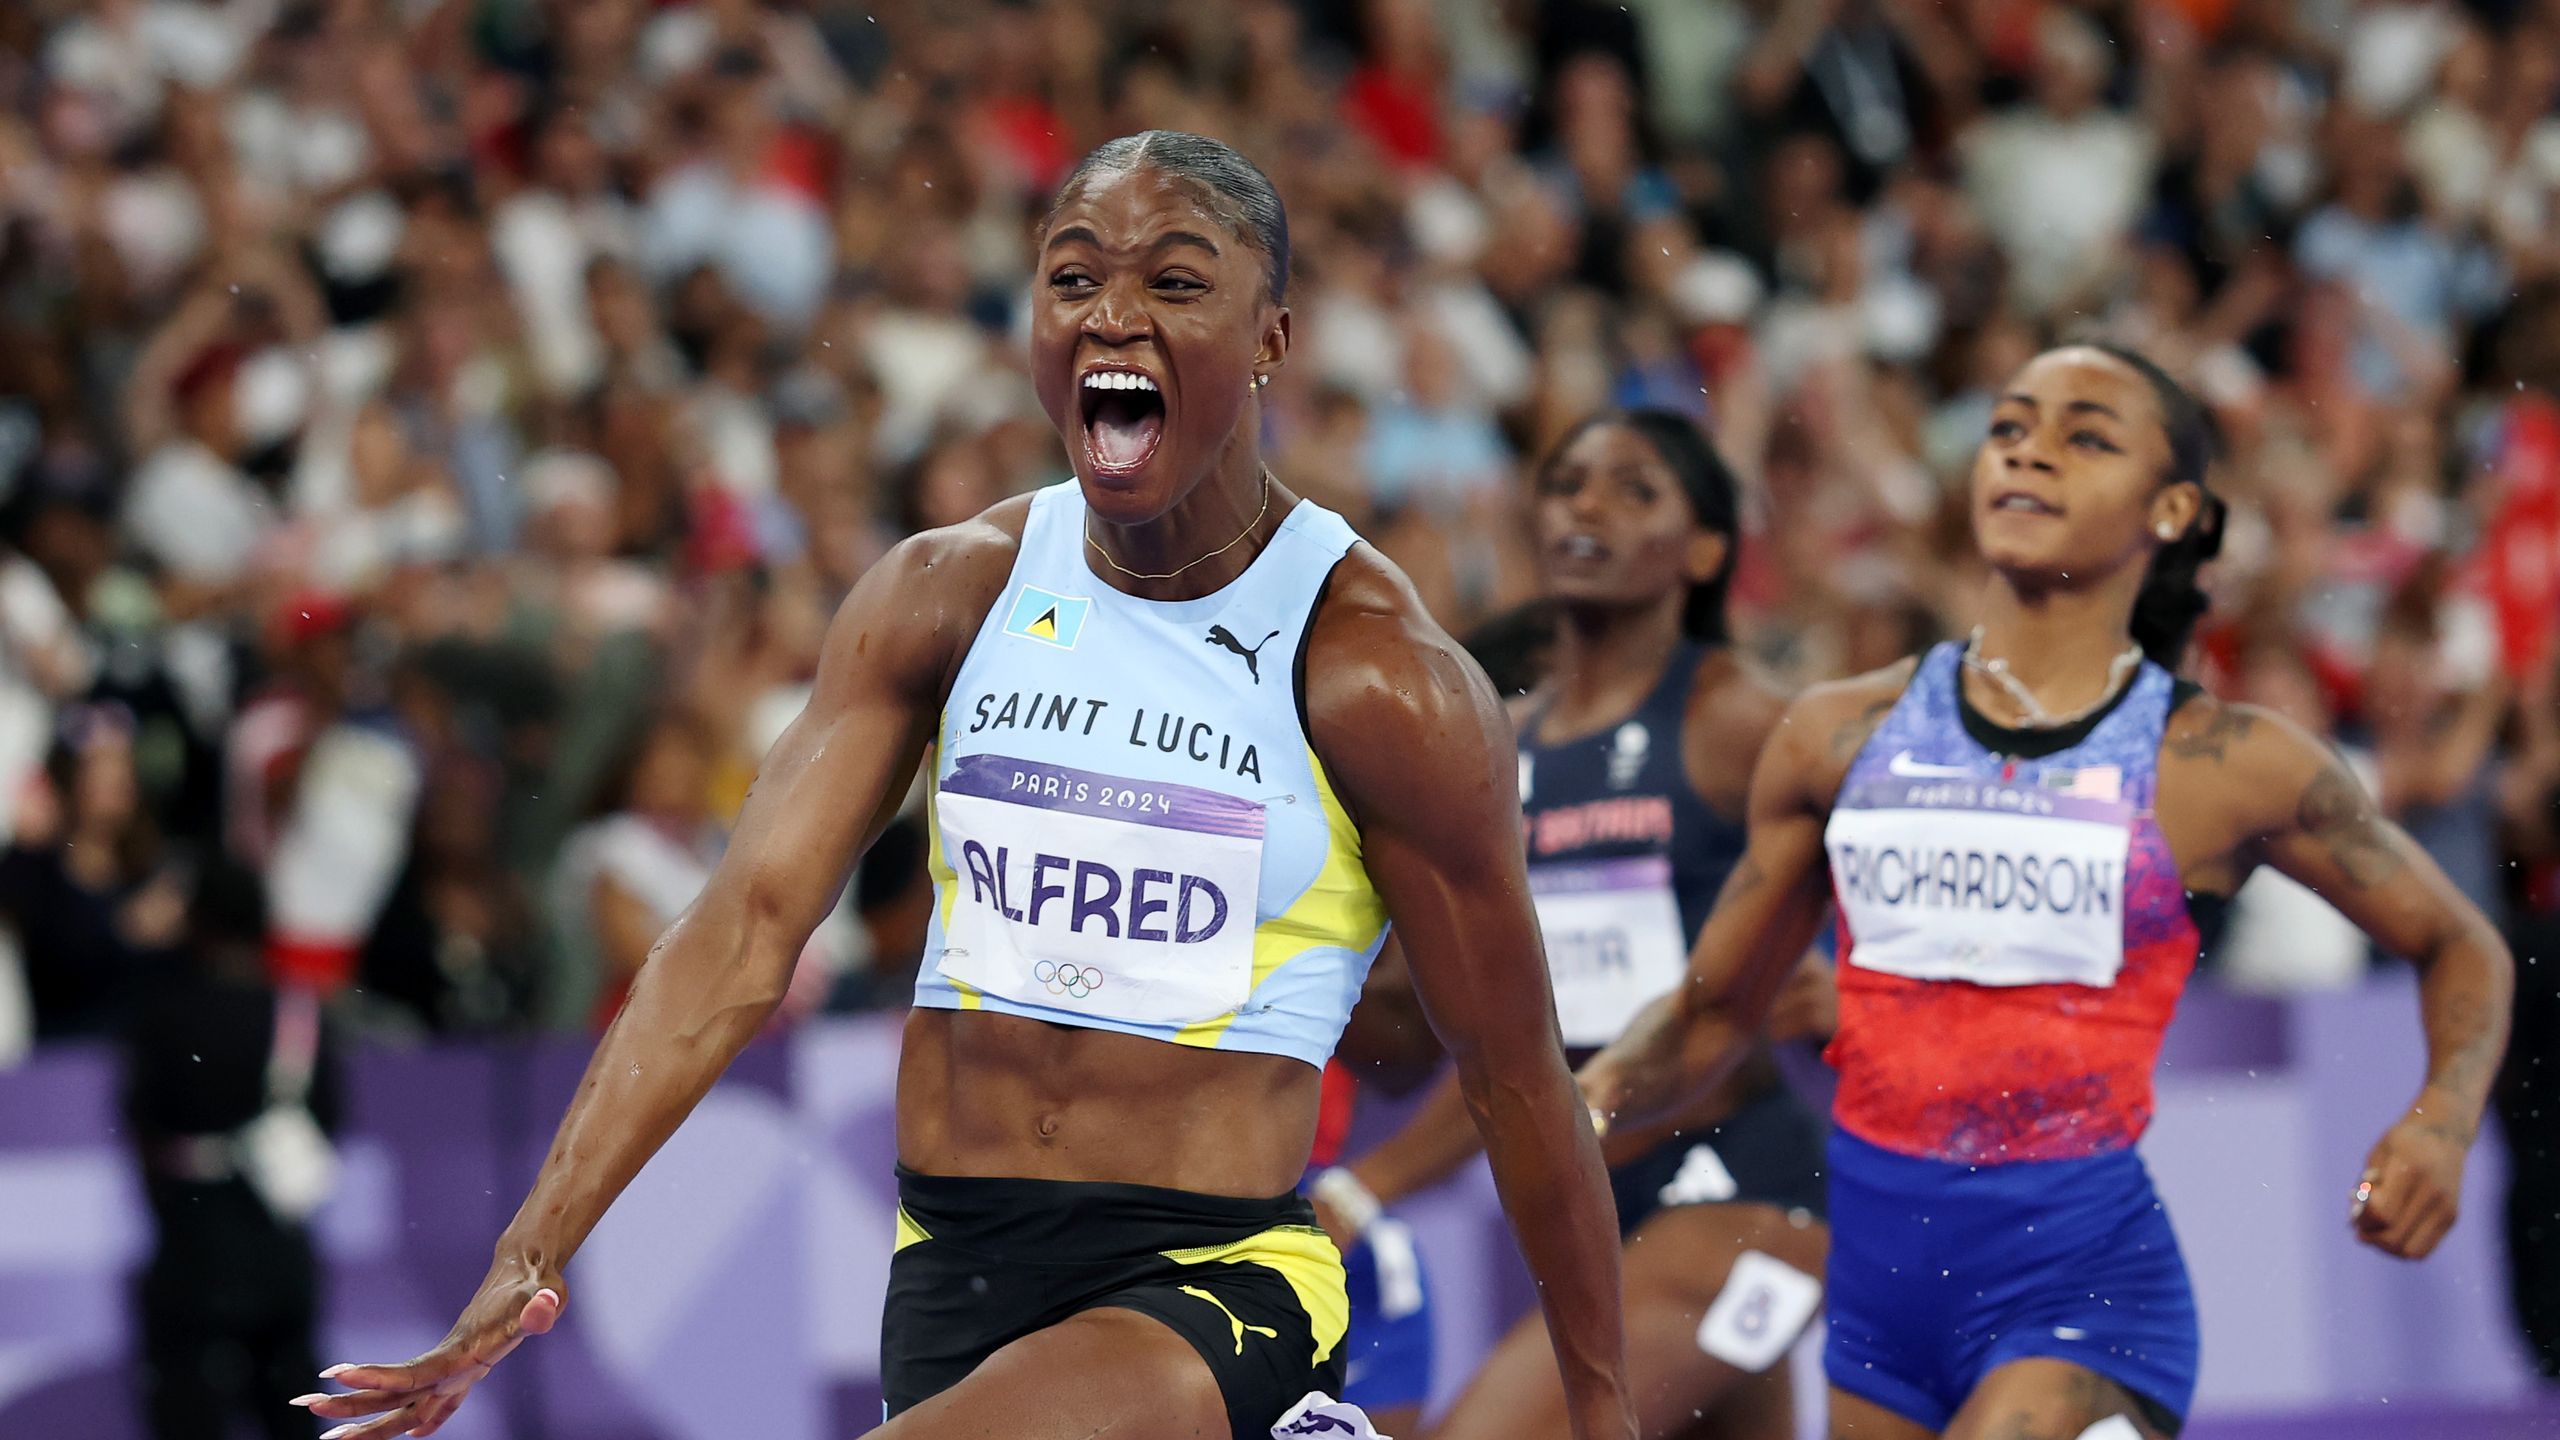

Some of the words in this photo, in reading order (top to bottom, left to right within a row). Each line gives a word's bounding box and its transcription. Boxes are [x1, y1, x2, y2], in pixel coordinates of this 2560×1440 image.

[970, 691, 1108, 734] SAINT
[1128, 708, 1262, 783] LUCIA
[1098, 786, 1171, 815] 2024
[962, 839, 1228, 945] ALFRED
[1840, 844, 2112, 914] RICHARDSON
